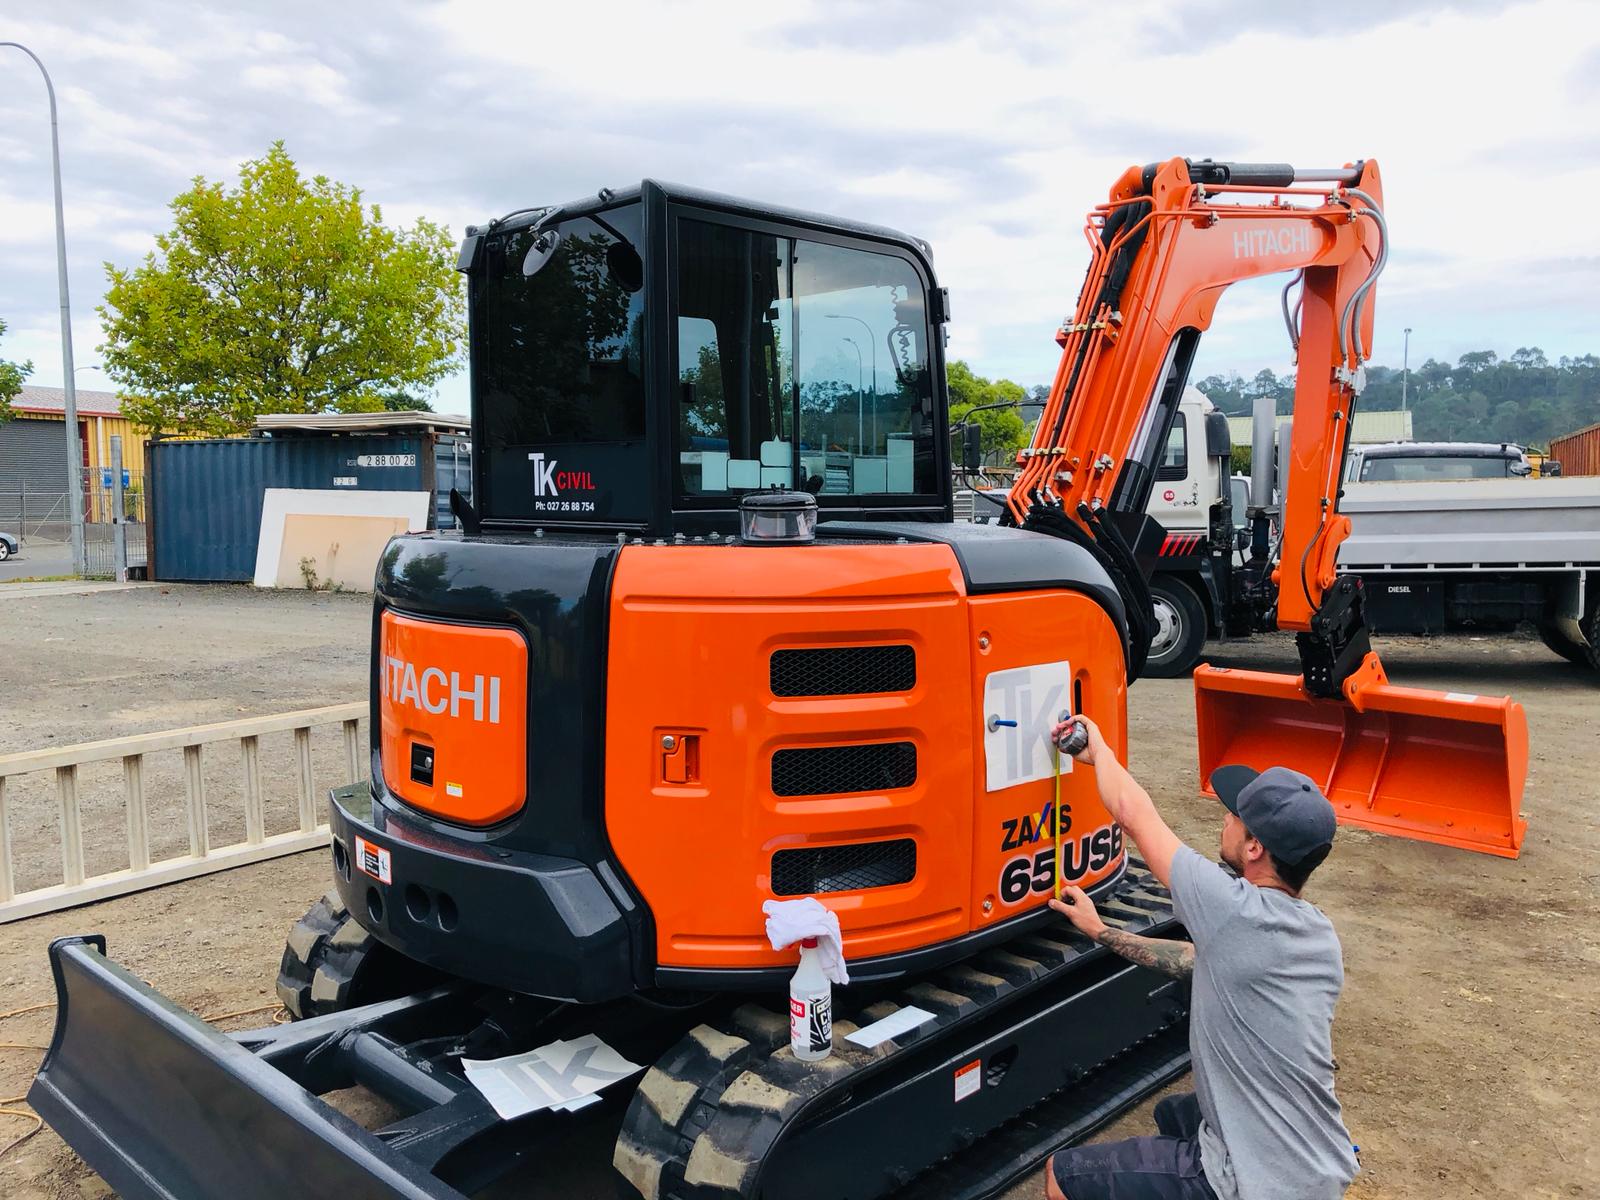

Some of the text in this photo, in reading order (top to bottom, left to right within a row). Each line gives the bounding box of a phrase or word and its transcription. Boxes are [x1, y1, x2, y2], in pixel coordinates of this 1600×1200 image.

[1232, 227, 1311, 258] HITACHI
[528, 452, 596, 496] TK CIVIL
[535, 501, 595, 511] Ph: 027 26 88 754
[1001, 802, 1072, 852] ZAXIS
